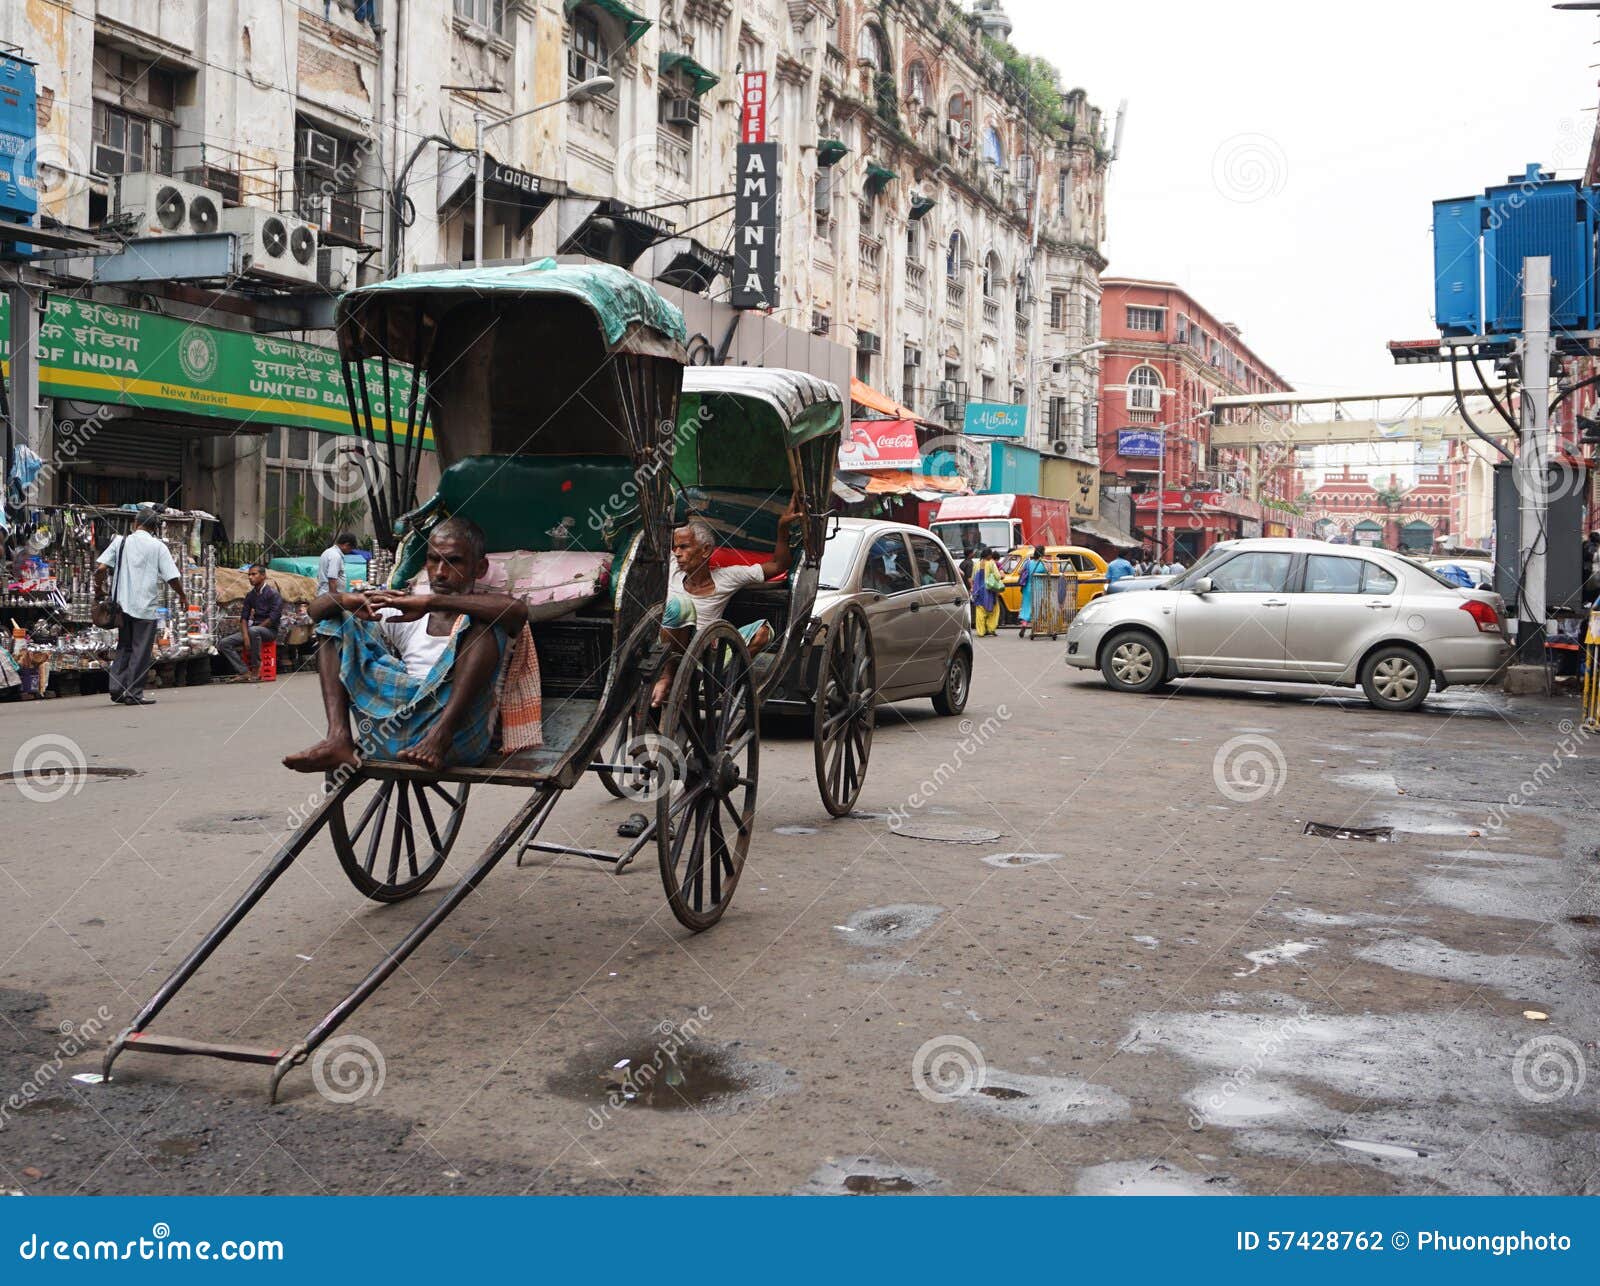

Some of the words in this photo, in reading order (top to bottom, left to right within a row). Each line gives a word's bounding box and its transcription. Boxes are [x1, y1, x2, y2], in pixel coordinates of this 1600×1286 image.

[495, 166, 539, 192] LODGE
[624, 205, 667, 231] AMINIA
[743, 153, 767, 292] AMINIA
[71, 324, 140, 352] इंडिया
[38, 345, 65, 361] OF
[73, 350, 139, 373] INDIA
[161, 385, 186, 398] New
[190, 390, 228, 404] Market
[249, 380, 318, 399] UNITED
[323, 391, 365, 410] BA
[974, 411, 1018, 430] Alibaba
